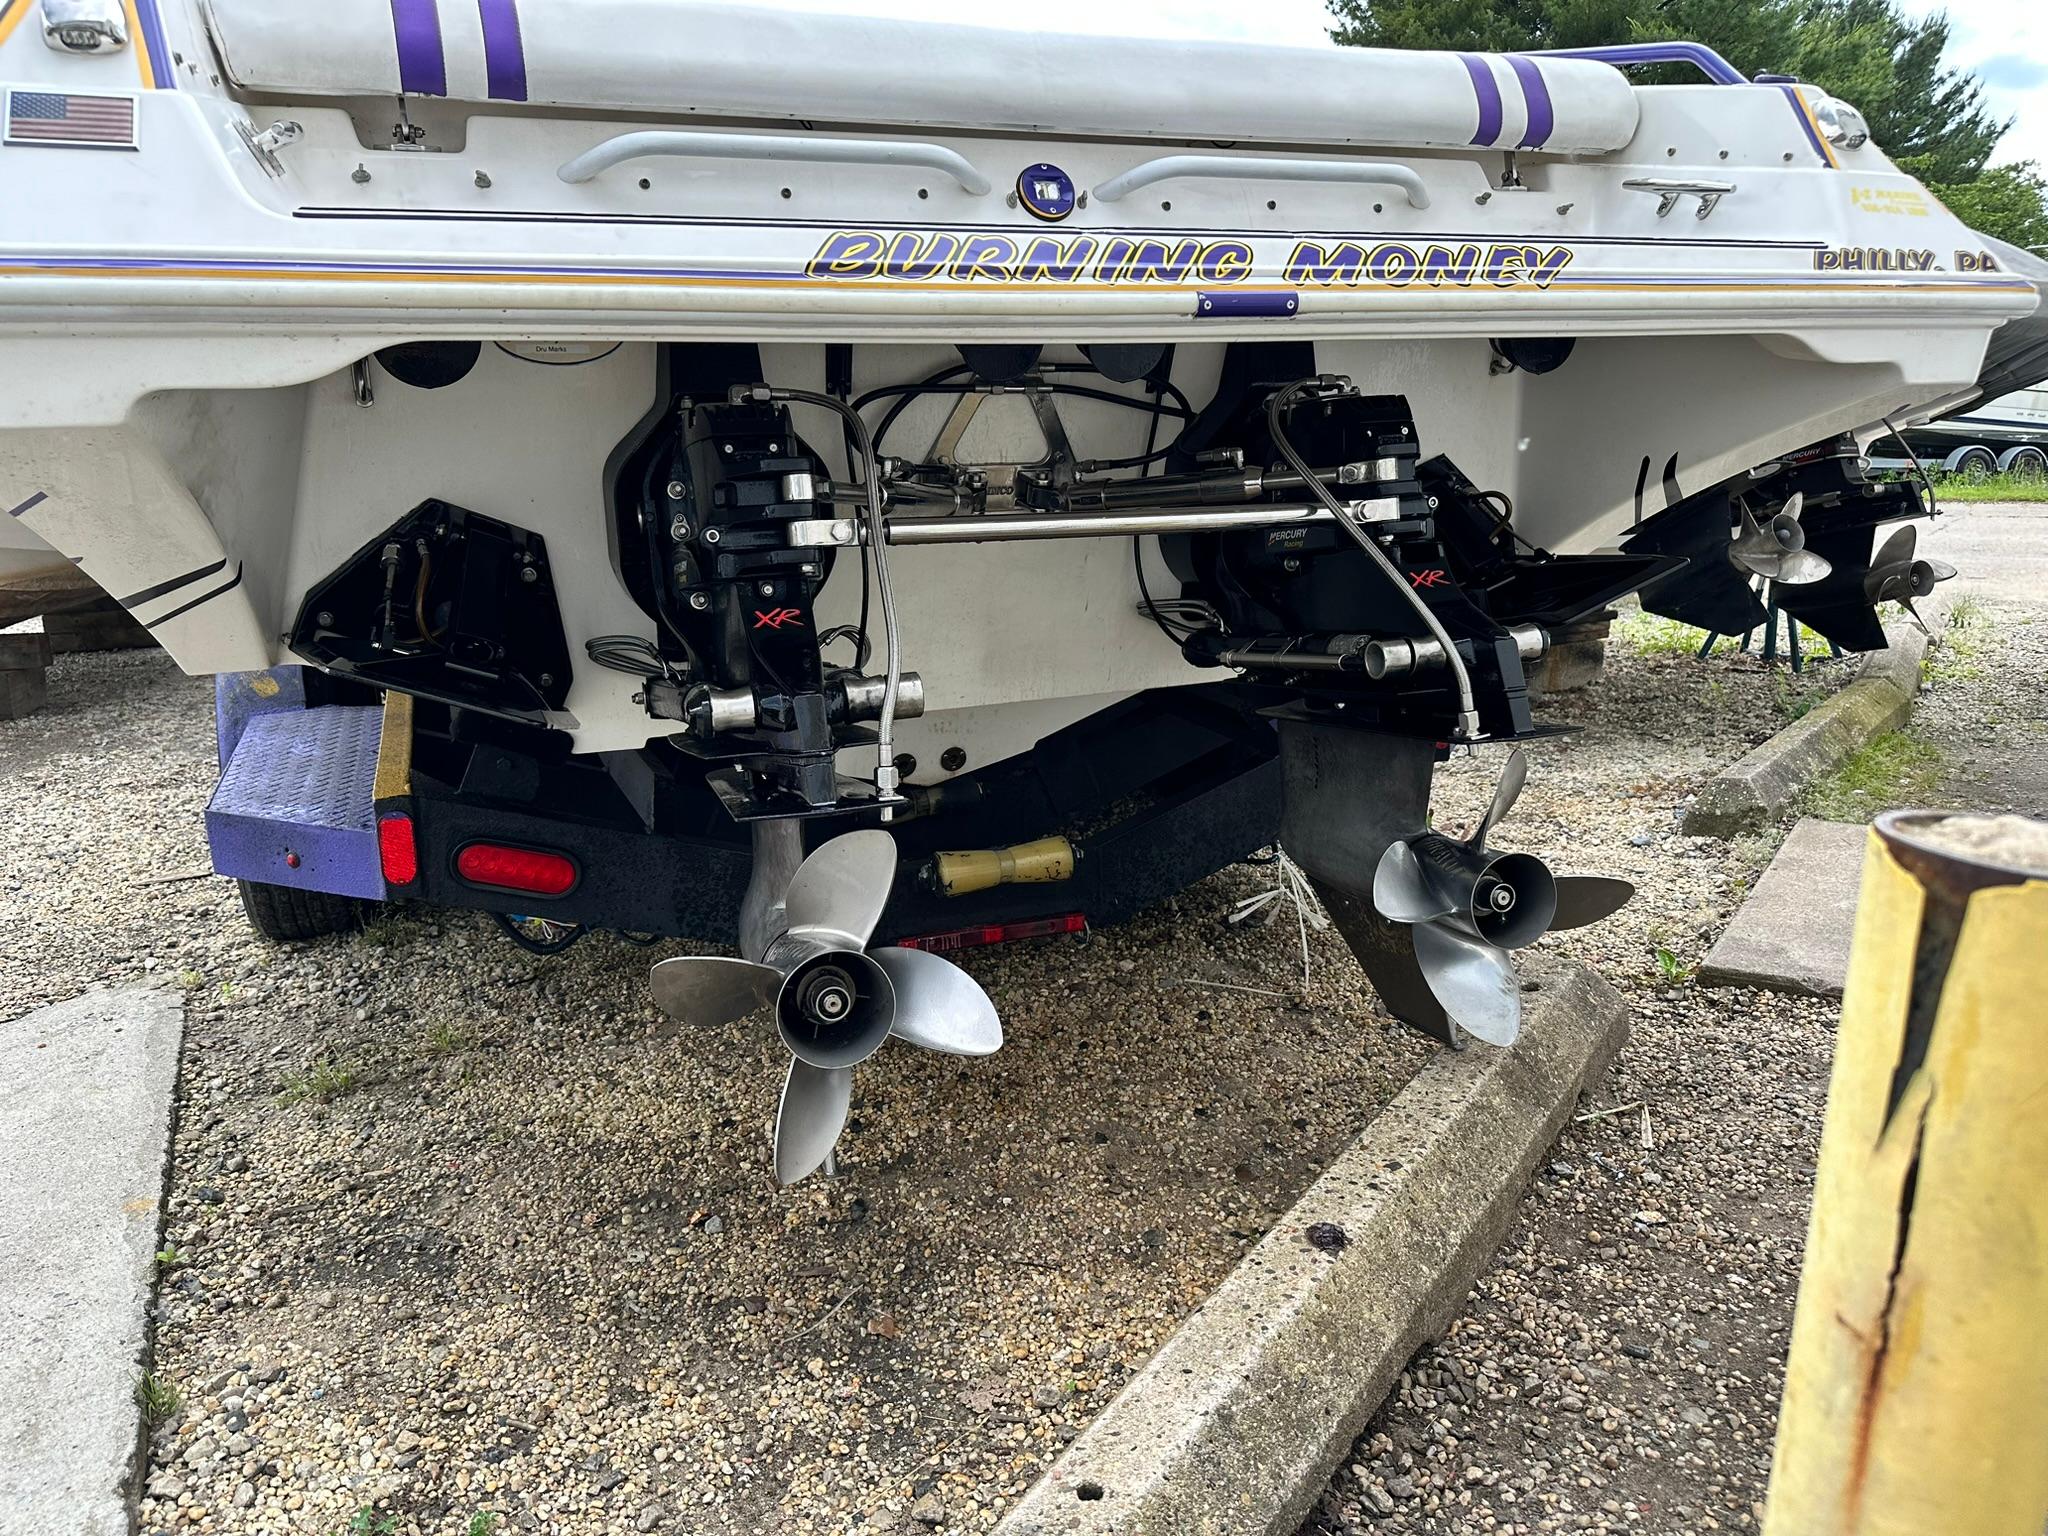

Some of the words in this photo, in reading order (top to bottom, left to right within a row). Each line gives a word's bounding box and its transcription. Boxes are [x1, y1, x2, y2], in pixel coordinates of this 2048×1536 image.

[804, 231, 1254, 285] BURNING
[1282, 238, 1574, 290] MONEY
[1955, 250, 2001, 272] PA
[1782, 447, 1821, 461] MERCURY
[1268, 528, 1308, 541] MERCURY
[1284, 540, 1304, 549] Racing
[1409, 569, 1451, 588] XR
[753, 607, 805, 629] XR
